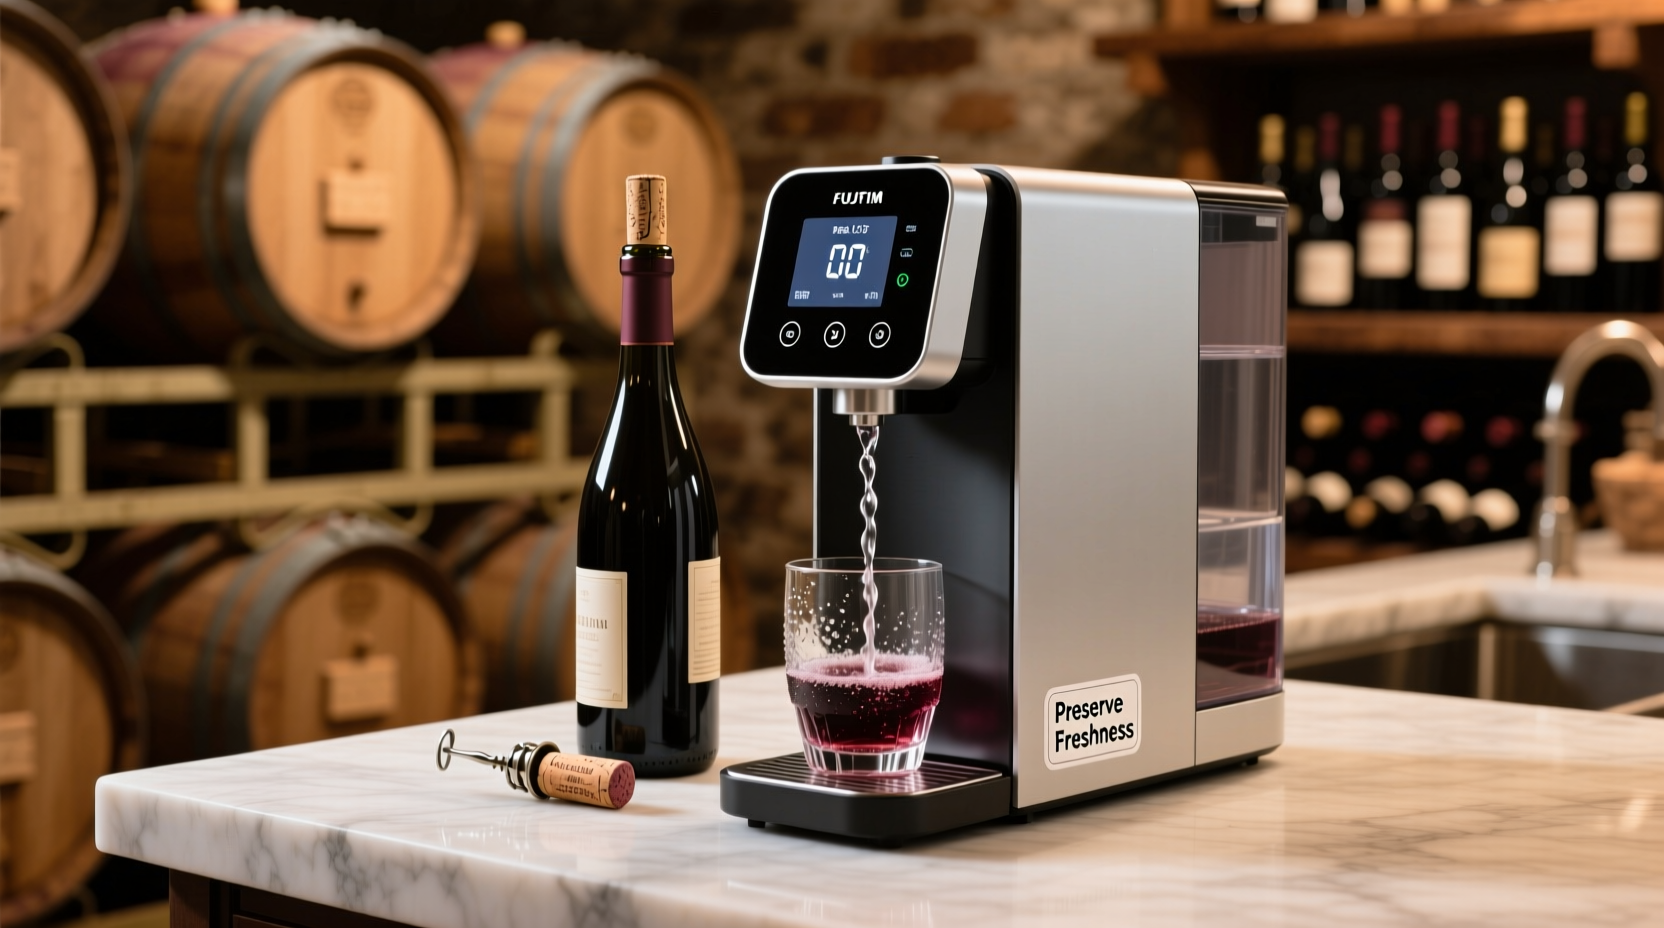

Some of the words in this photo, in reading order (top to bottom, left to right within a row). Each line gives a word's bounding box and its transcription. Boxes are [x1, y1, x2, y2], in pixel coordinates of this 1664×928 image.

[826, 244, 866, 279] 00
[1055, 697, 1124, 724] Preserve
[1055, 722, 1134, 753] Freshness
